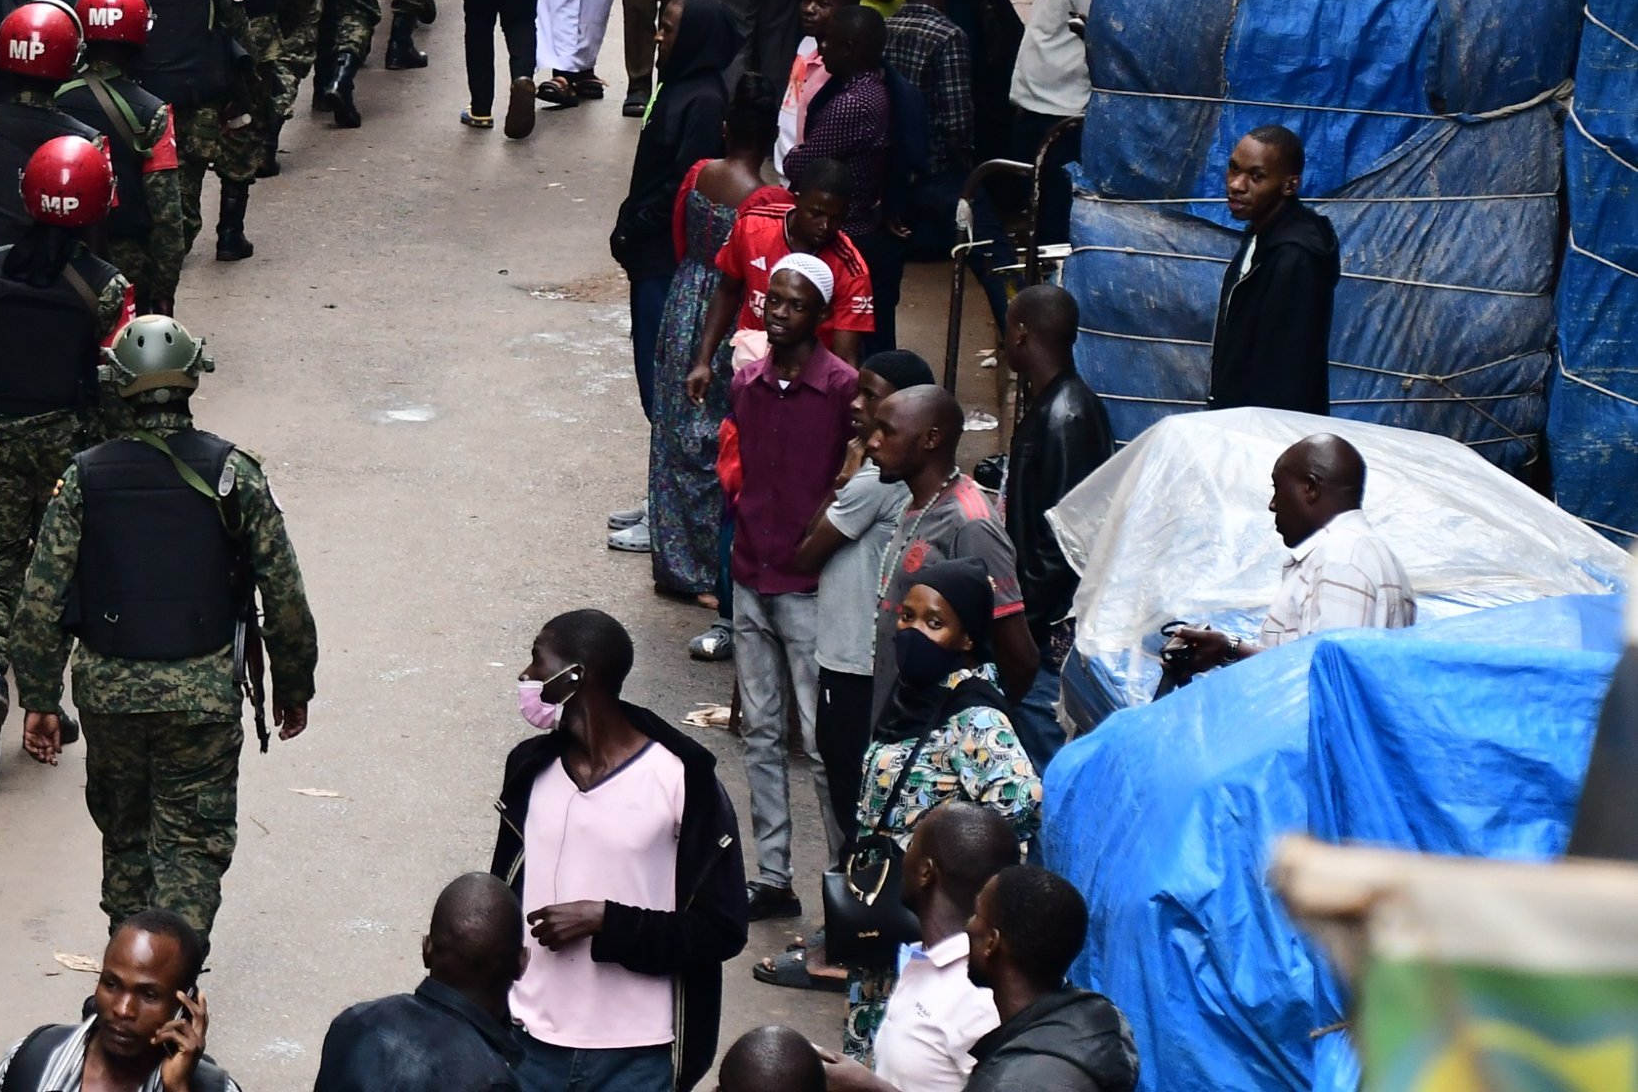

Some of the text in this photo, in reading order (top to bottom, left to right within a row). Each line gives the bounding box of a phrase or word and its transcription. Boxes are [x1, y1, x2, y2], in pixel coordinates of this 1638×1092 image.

[88, 7, 123, 27] MP
[9, 38, 46, 61] MP
[40, 194, 80, 214] MP
